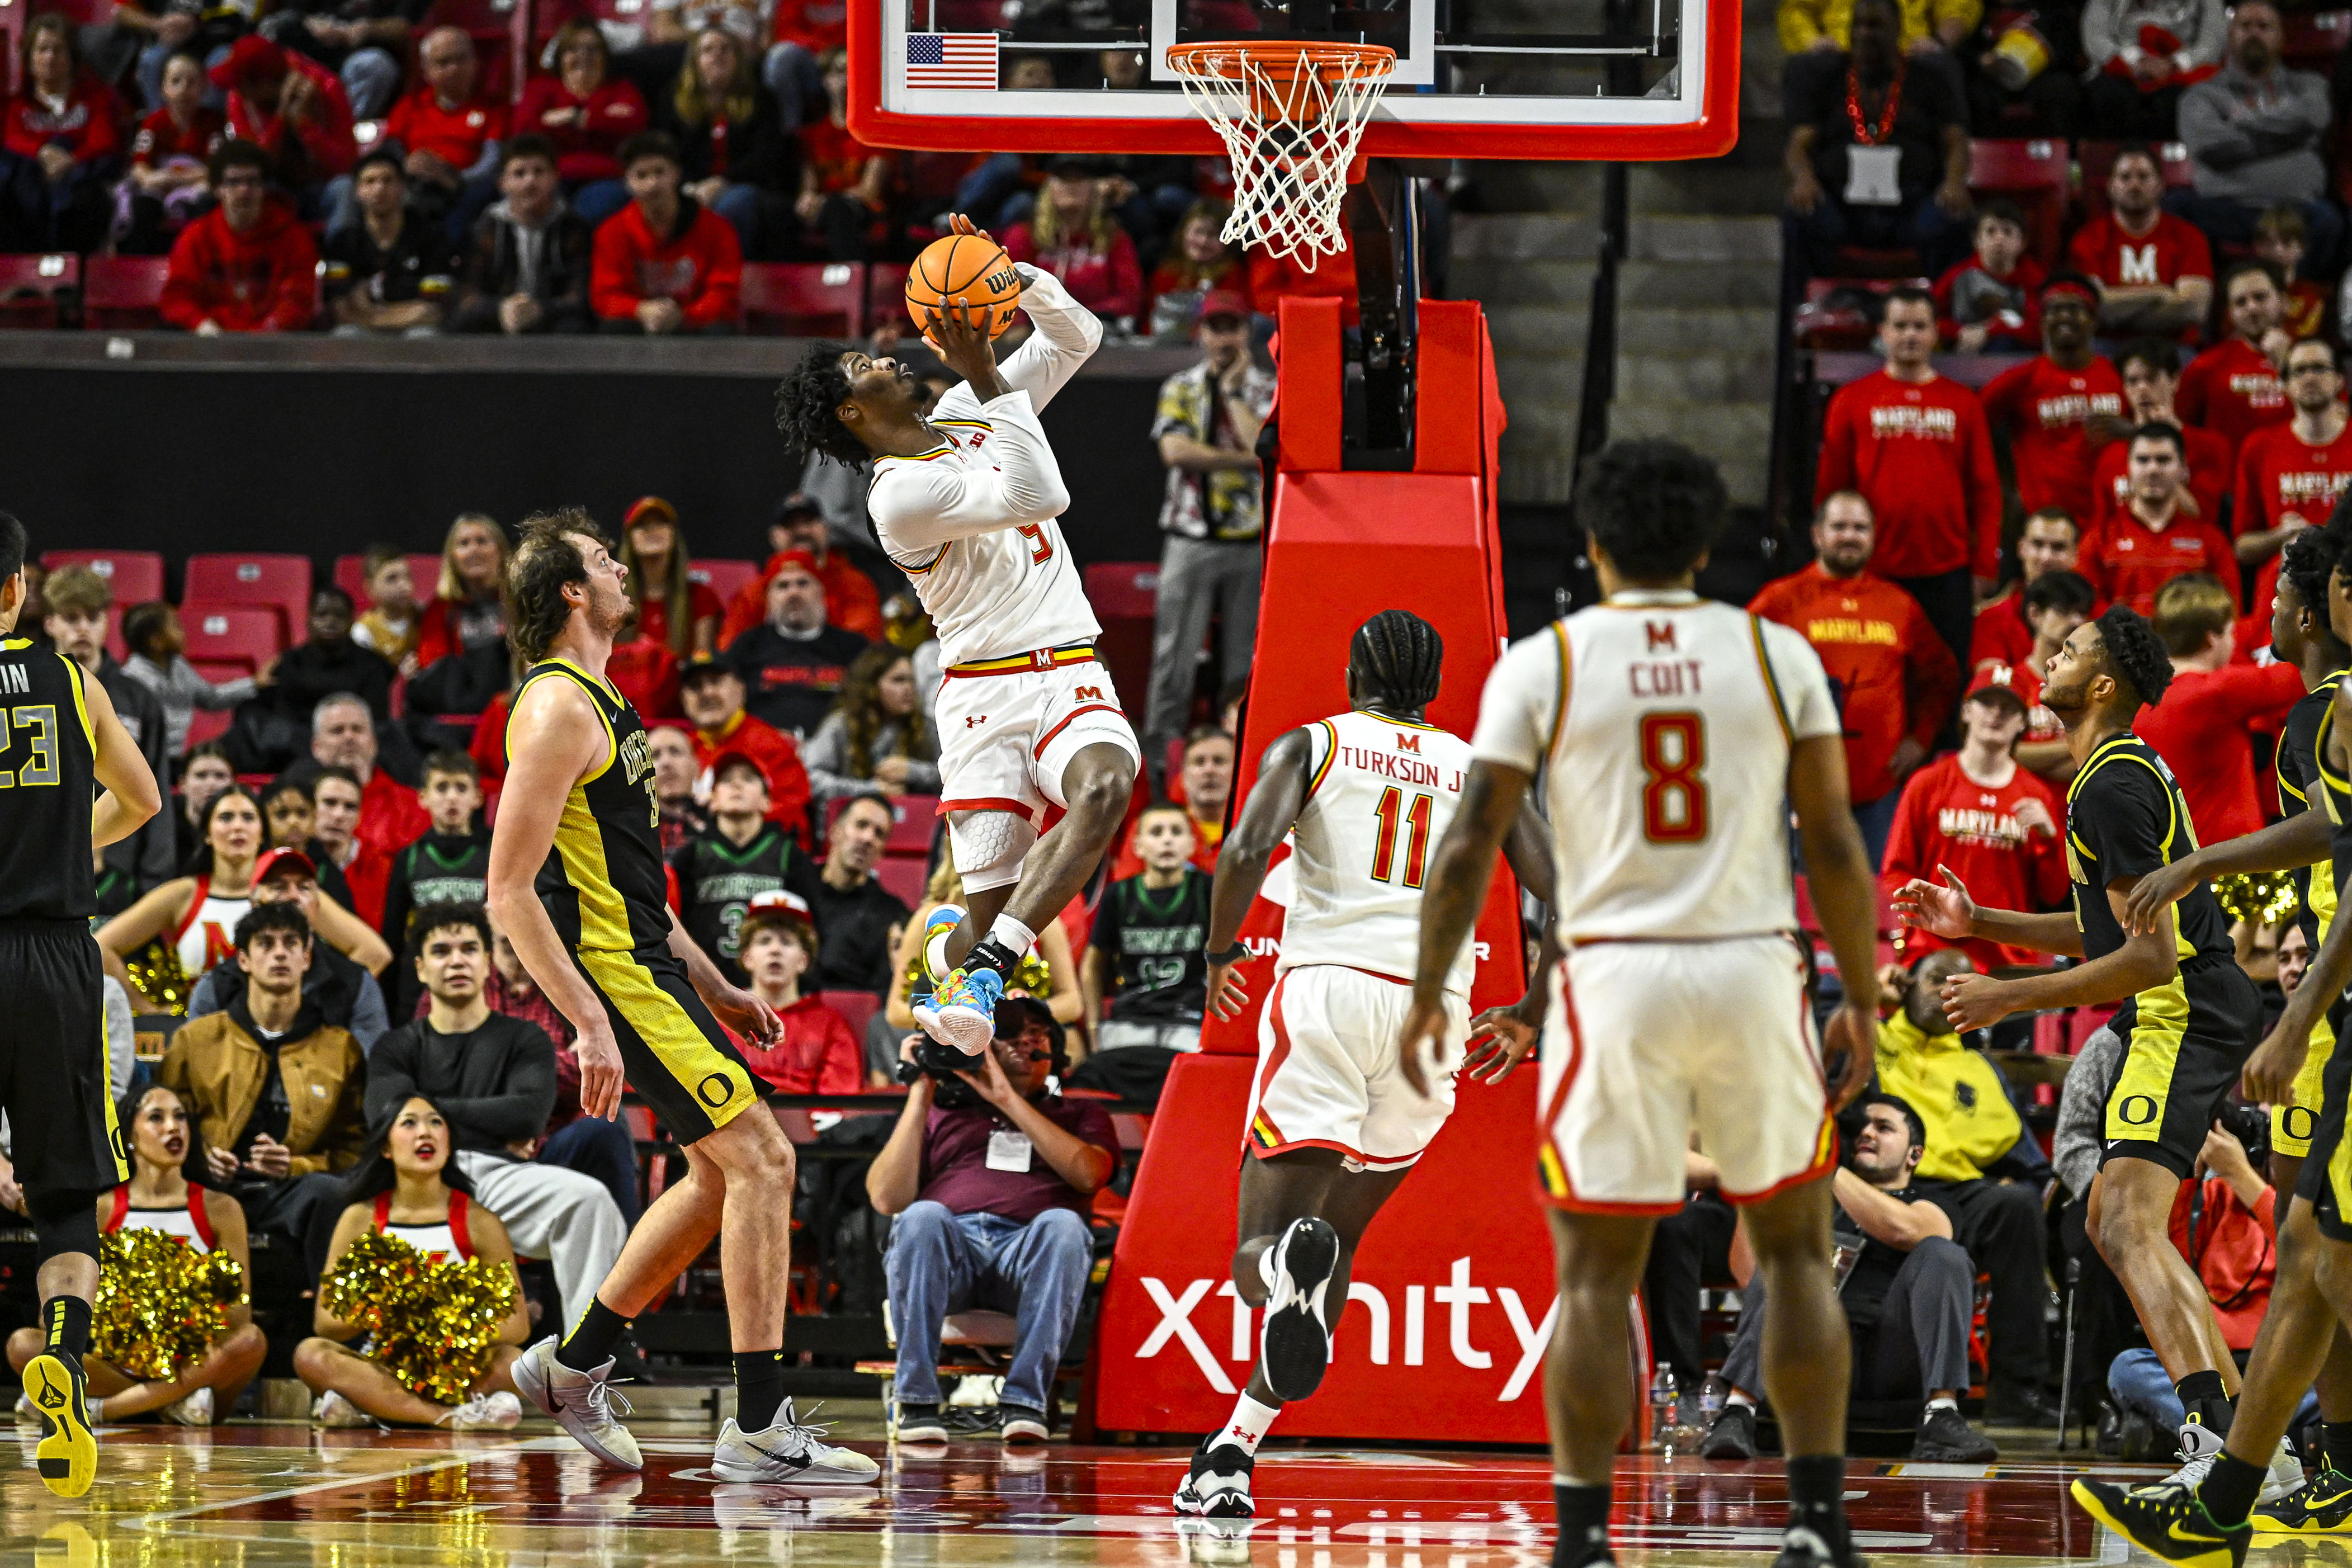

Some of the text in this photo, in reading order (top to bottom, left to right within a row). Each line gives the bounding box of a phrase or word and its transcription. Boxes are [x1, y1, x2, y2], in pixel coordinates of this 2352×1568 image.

[2120, 244, 2157, 284] M
[984, 265, 1018, 295] Wil
[1646, 620, 1677, 651] M
[1808, 618, 1897, 646] MARYLAND
[1035, 649, 1052, 667] M
[0, 663, 30, 695] IN
[1629, 658, 1704, 698] COIT
[1992, 665, 2013, 686] M
[1074, 686, 1106, 701] M
[1396, 733, 1421, 753] M
[1342, 747, 1468, 792] TURKSON J
[1636, 707, 1711, 849] 8
[1371, 785, 1433, 890] 11
[697, 1073, 734, 1108] O
[2119, 1095, 2157, 1125] O
[2282, 1106, 2321, 1140] O
